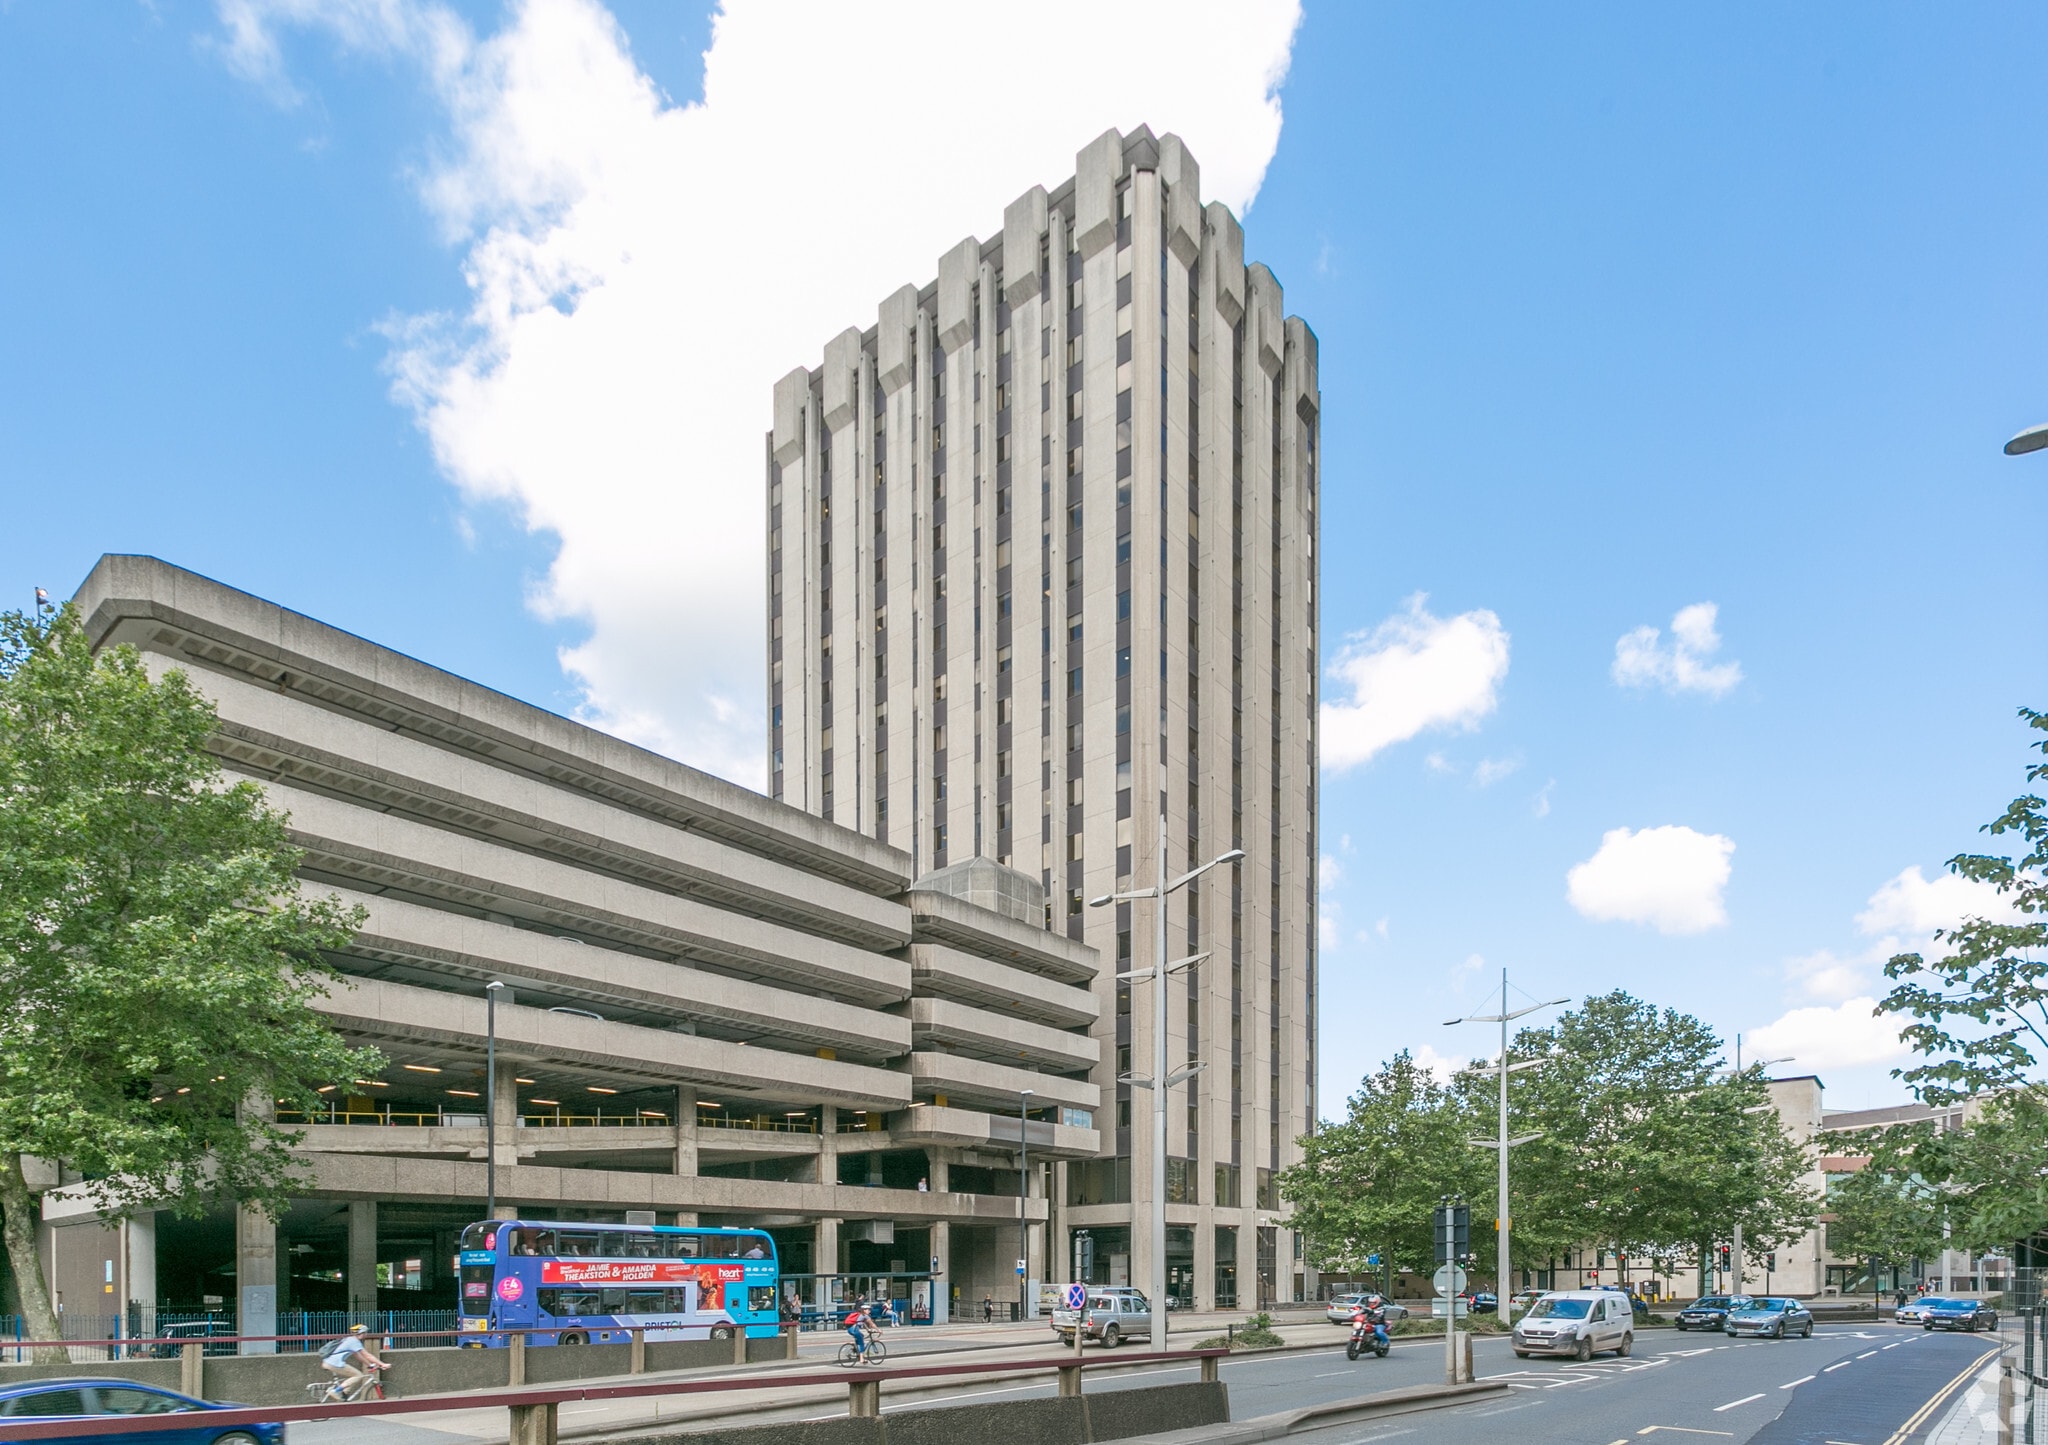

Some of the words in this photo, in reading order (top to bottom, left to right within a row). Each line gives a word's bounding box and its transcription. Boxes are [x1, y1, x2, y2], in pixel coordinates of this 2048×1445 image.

[586, 1264, 610, 1272] JAMIE
[612, 1266, 620, 1277] &
[622, 1264, 656, 1274] AMANDA
[718, 1268, 740, 1278] heart
[565, 1271, 610, 1281] THEAKSTON
[622, 1272, 653, 1280] HOLDEN
[503, 1278, 519, 1290] £4
